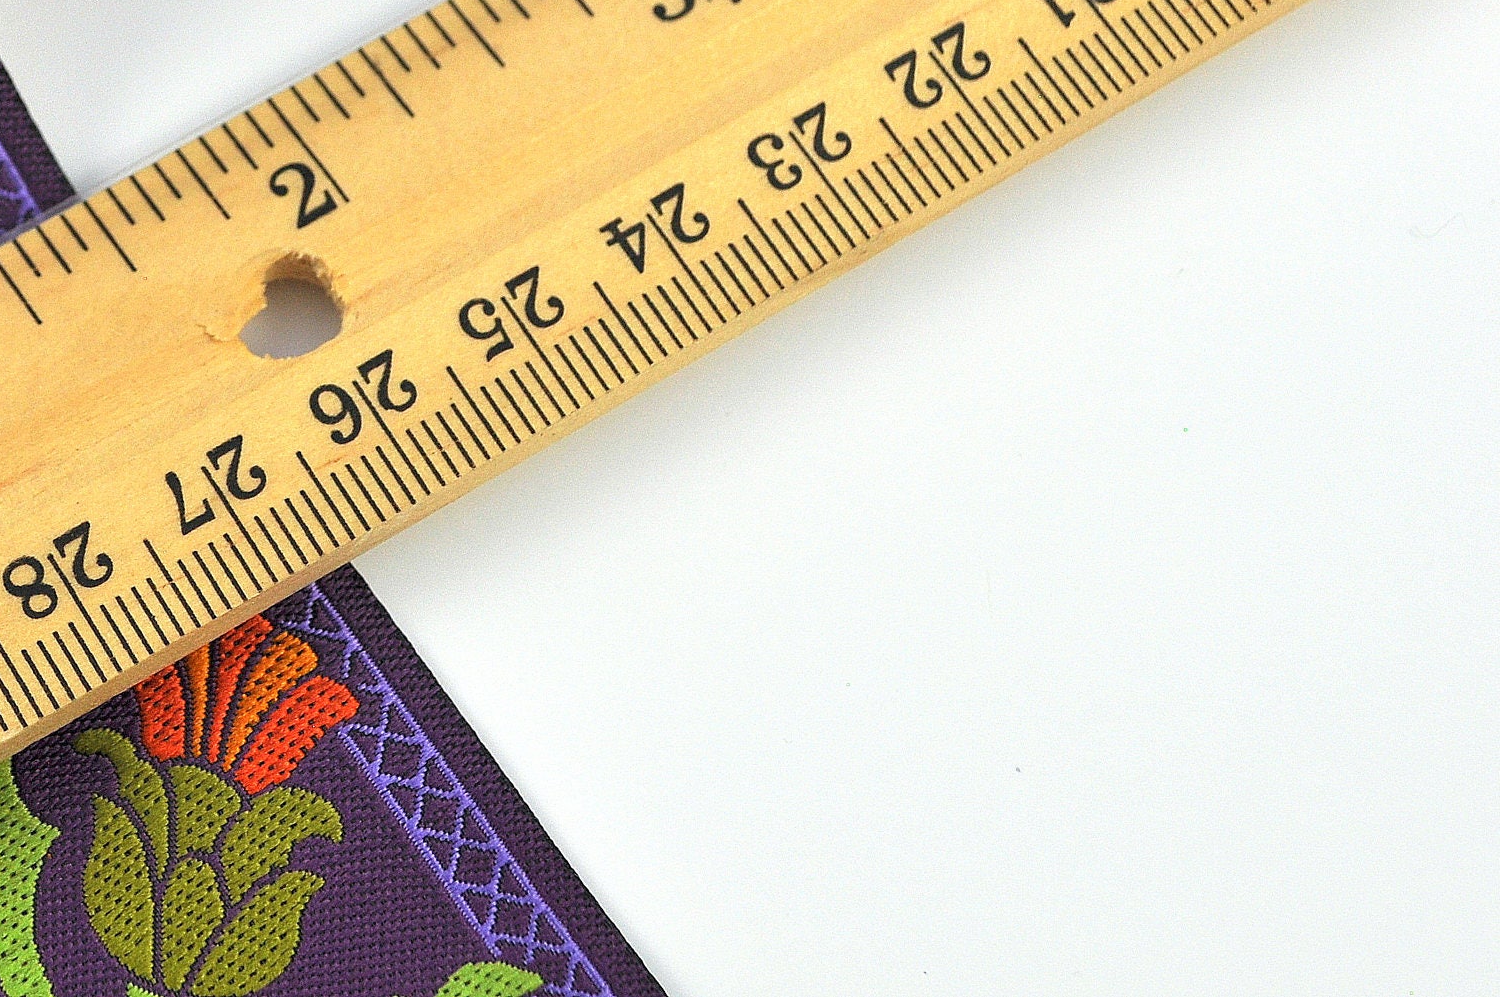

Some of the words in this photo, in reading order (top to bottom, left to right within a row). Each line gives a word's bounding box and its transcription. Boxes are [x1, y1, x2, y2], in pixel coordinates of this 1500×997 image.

[884, 22, 991, 109] 22
[746, 102, 852, 191] 23
[269, 161, 336, 229] 2
[600, 183, 710, 274] 24
[458, 266, 565, 360] 25
[309, 349, 417, 444] 26
[164, 435, 267, 535] 27
[2, 521, 114, 619] 28
